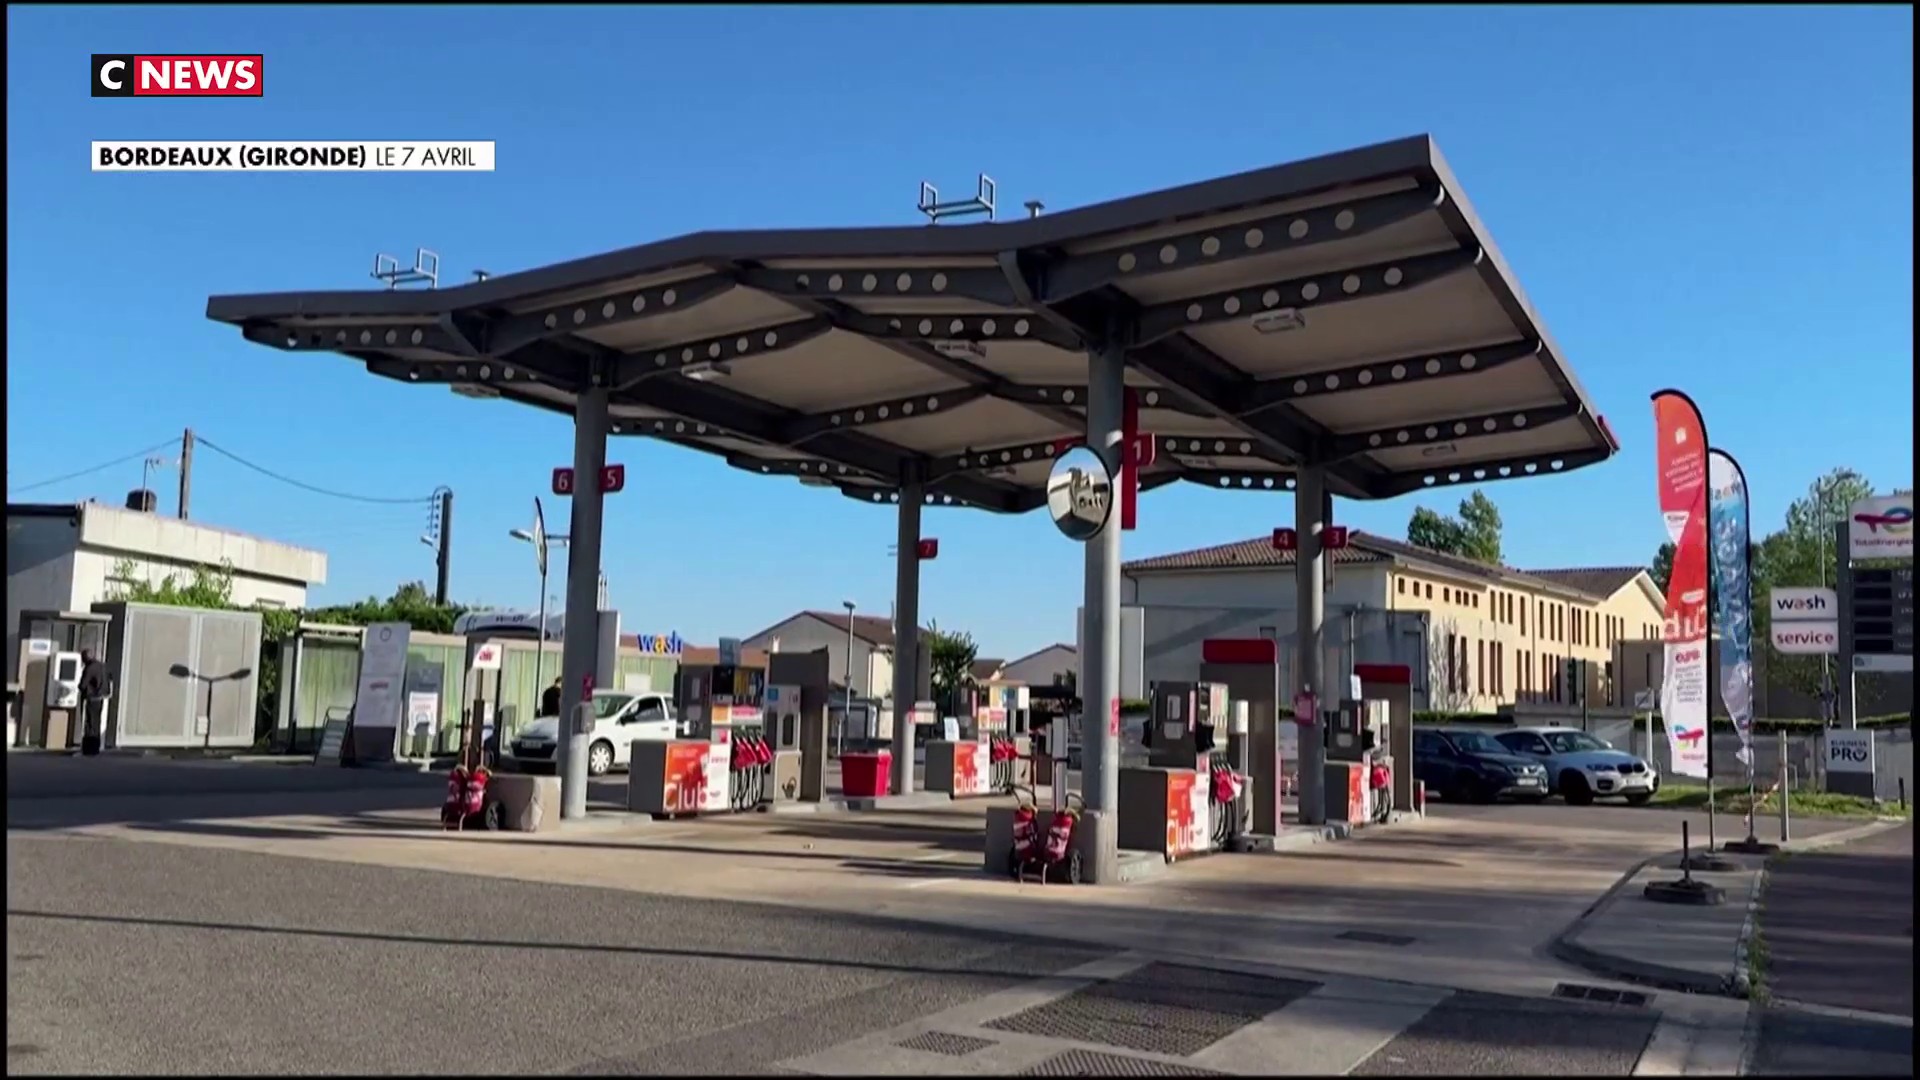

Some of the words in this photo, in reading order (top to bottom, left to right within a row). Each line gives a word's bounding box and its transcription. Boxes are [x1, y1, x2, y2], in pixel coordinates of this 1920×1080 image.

[1133, 440, 1142, 461] 1
[558, 472, 568, 491] 6
[607, 470, 617, 488] 5
[1279, 532, 1289, 547] 4
[1331, 531, 1340, 545] 3
[1777, 594, 1826, 610] wash
[637, 629, 682, 655] wash
[1777, 630, 1835, 645] service
